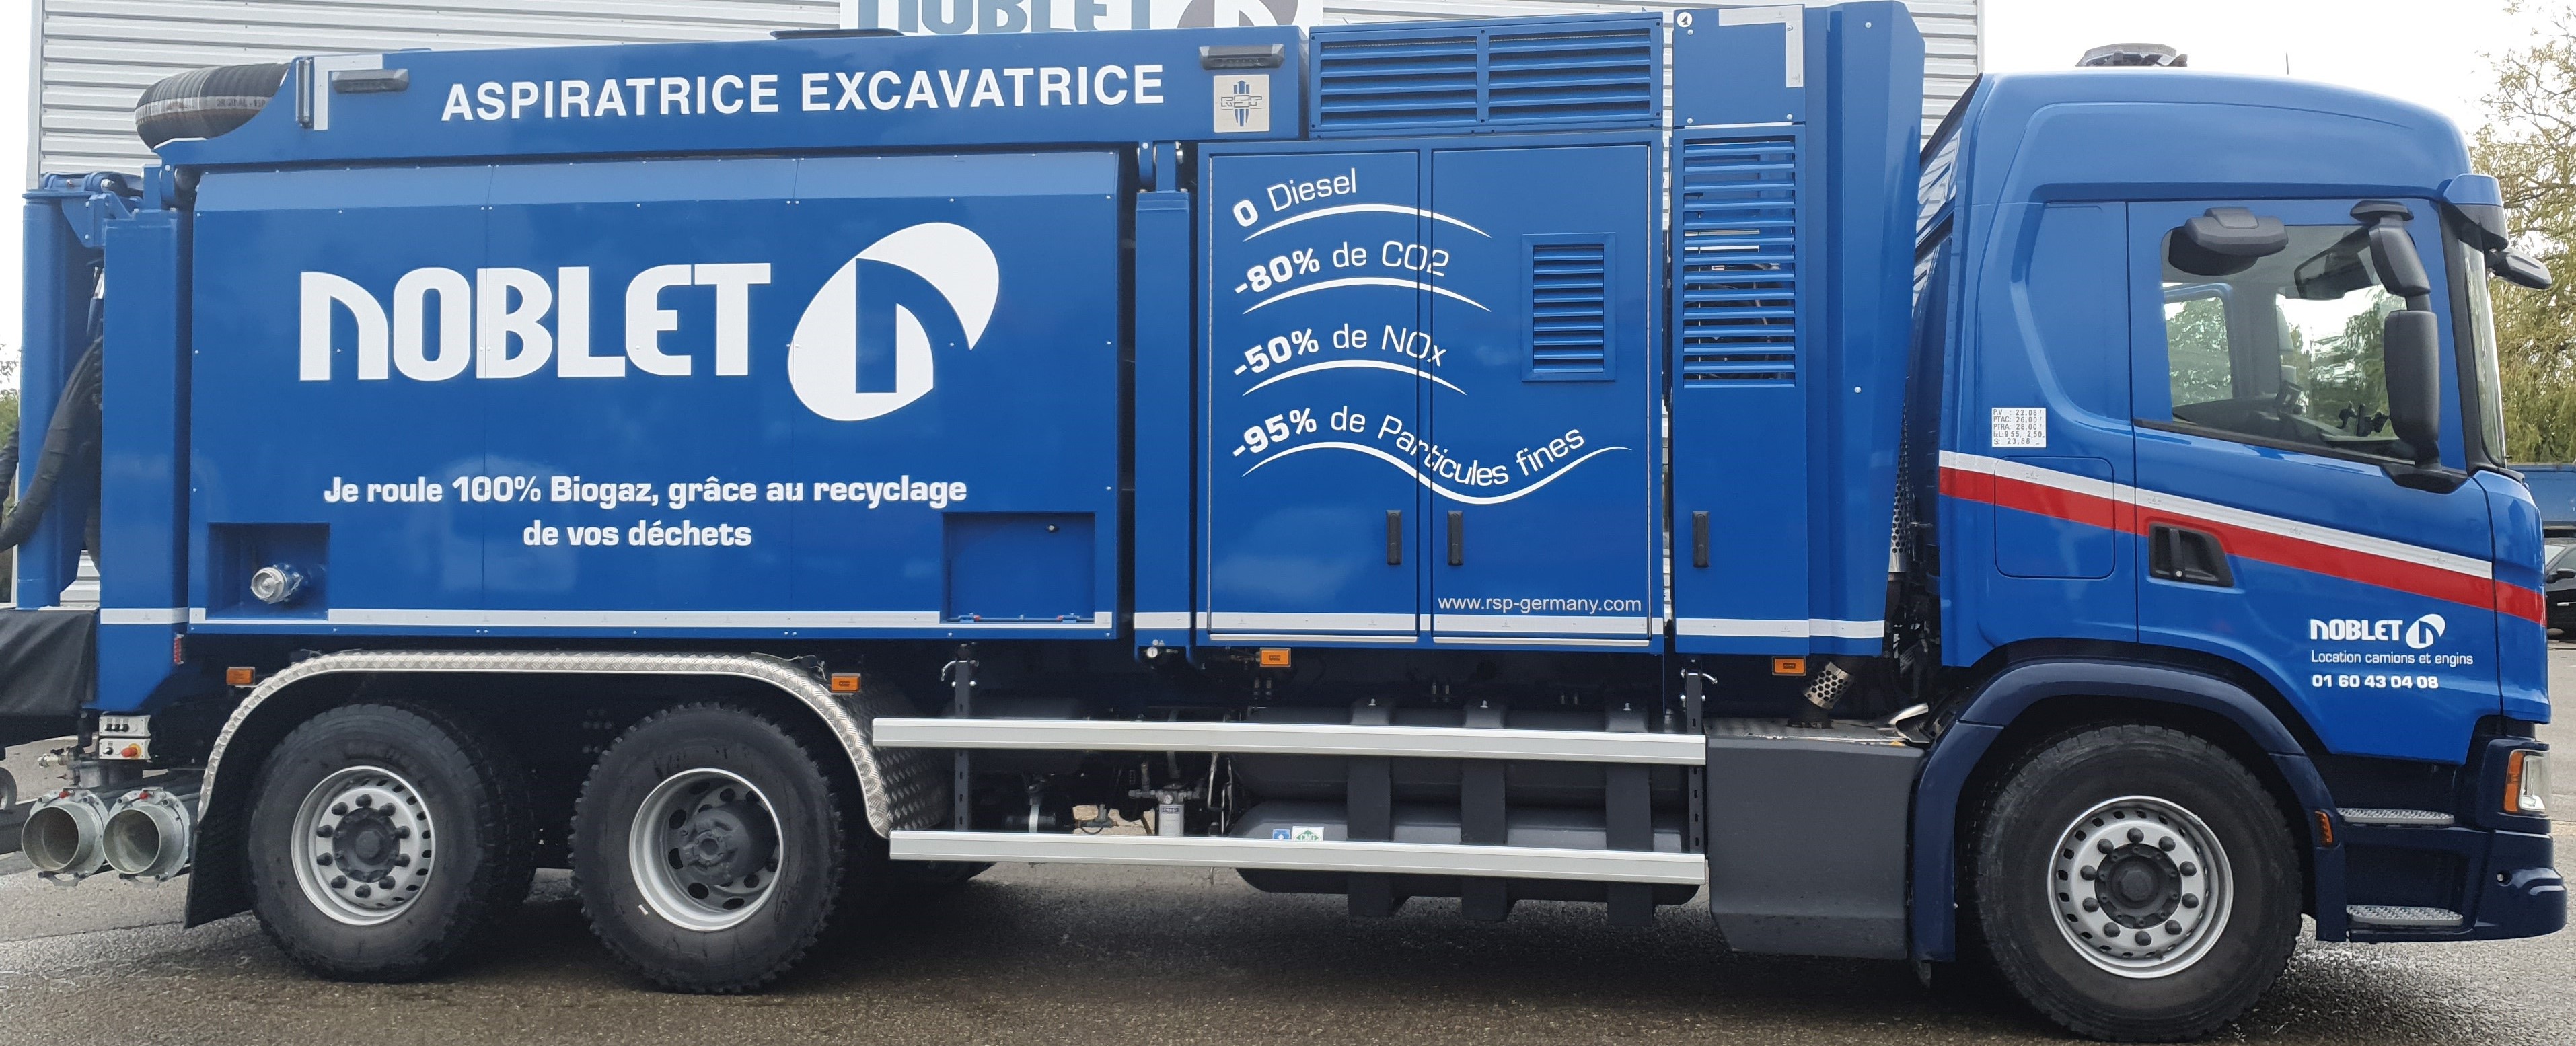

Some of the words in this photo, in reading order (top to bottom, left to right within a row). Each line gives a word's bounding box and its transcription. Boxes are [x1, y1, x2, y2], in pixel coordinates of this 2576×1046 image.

[441, 75, 778, 121] ASPIRATRICE
[803, 65, 1163, 111] EXCAVATRICE
[1233, 200, 1258, 227] 0
[1267, 168, 1357, 213] Diesel
[1235, 248, 1320, 295] -80%
[1333, 242, 1366, 267] de
[1383, 241, 1448, 276] CO2
[300, 263, 770, 381] NOBLET
[1235, 328, 1319, 376] -50%
[1333, 324, 1366, 348] de
[1381, 325, 1446, 367] NOx
[1233, 408, 1317, 458] -95%
[1331, 406, 1365, 432] de
[1377, 415, 1510, 486] Particules
[1516, 428, 1585, 474] fines
[324, 477, 357, 502] Je
[368, 477, 442, 502] roule
[453, 476, 540, 501] 100%
[552, 476, 658, 509] Biogaz,
[669, 476, 756, 509] grâce
[767, 483, 803, 501] au
[815, 476, 966, 509] recyclage
[524, 520, 558, 545] de
[567, 527, 619, 545] vos
[629, 520, 751, 546] déchets
[1438, 598, 1641, 614] www.rsp-germany.com
[2311, 620, 2402, 640] NOBLET
[2312, 650, 2361, 662] Location
[2365, 651, 2415, 664] camions
[2419, 654, 2431, 663] et
[2435, 652, 2474, 667] engins
[2313, 675, 2331, 687] 01
[2339, 675, 2359, 687] 60
[2365, 675, 2386, 687] 43
[2391, 676, 2412, 687] 04
[2417, 676, 2438, 688] 08
